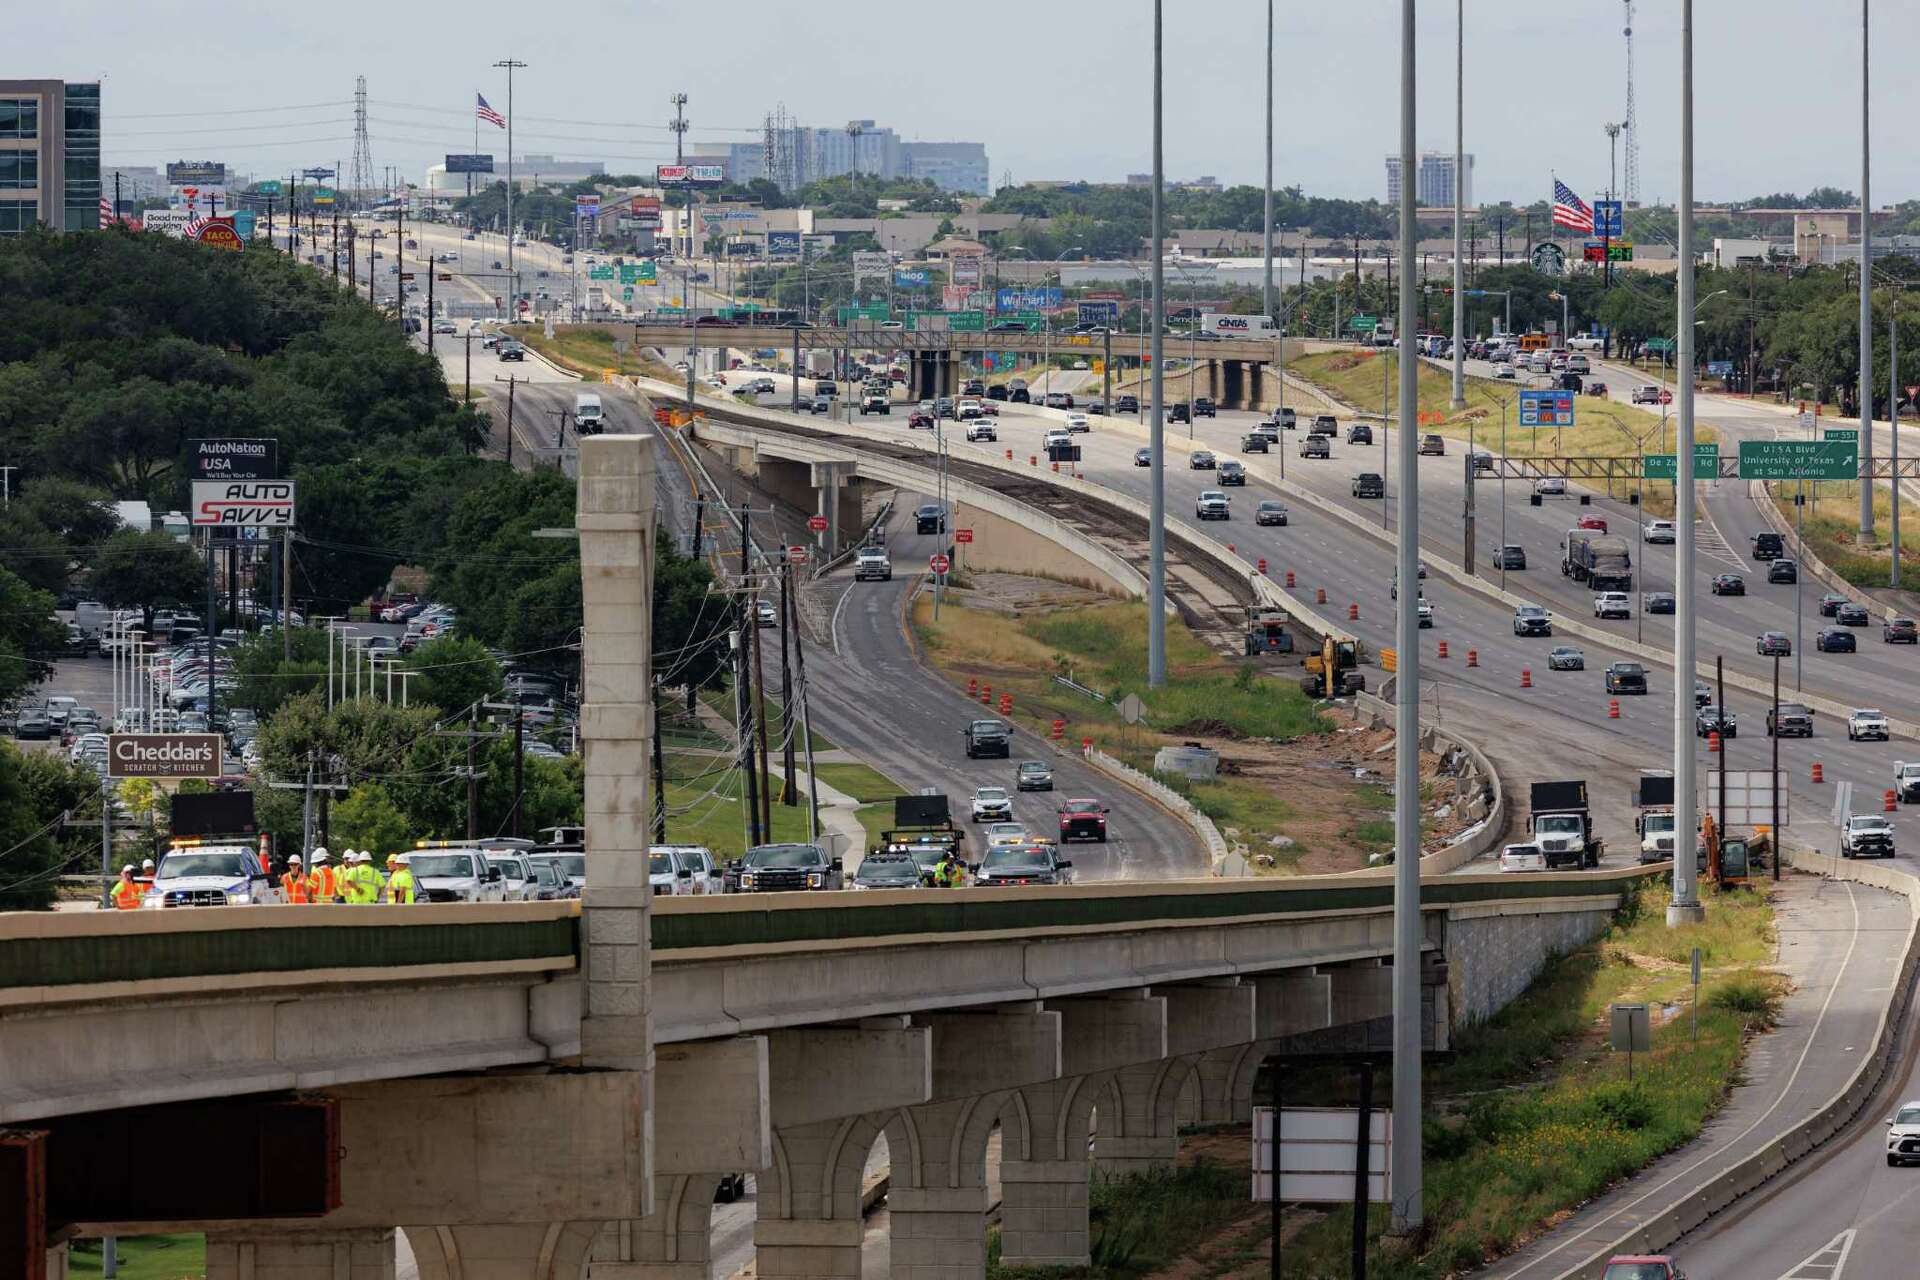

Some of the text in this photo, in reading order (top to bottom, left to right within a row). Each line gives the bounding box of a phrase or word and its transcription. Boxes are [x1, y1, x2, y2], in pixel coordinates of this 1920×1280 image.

[148, 213, 171, 221] Good
[207, 231, 233, 240] TACO
[1002, 295, 1046, 305] Walmart
[199, 442, 266, 454] AutoNation
[204, 459, 232, 470] USA
[1744, 456, 1834, 467] University of Texas
[226, 485, 290, 499] AUTO
[194, 502, 292, 523] SAVVY
[116, 740, 213, 760] Cheddar's
[124, 764, 206, 772] SCRATCH KITCHEN
